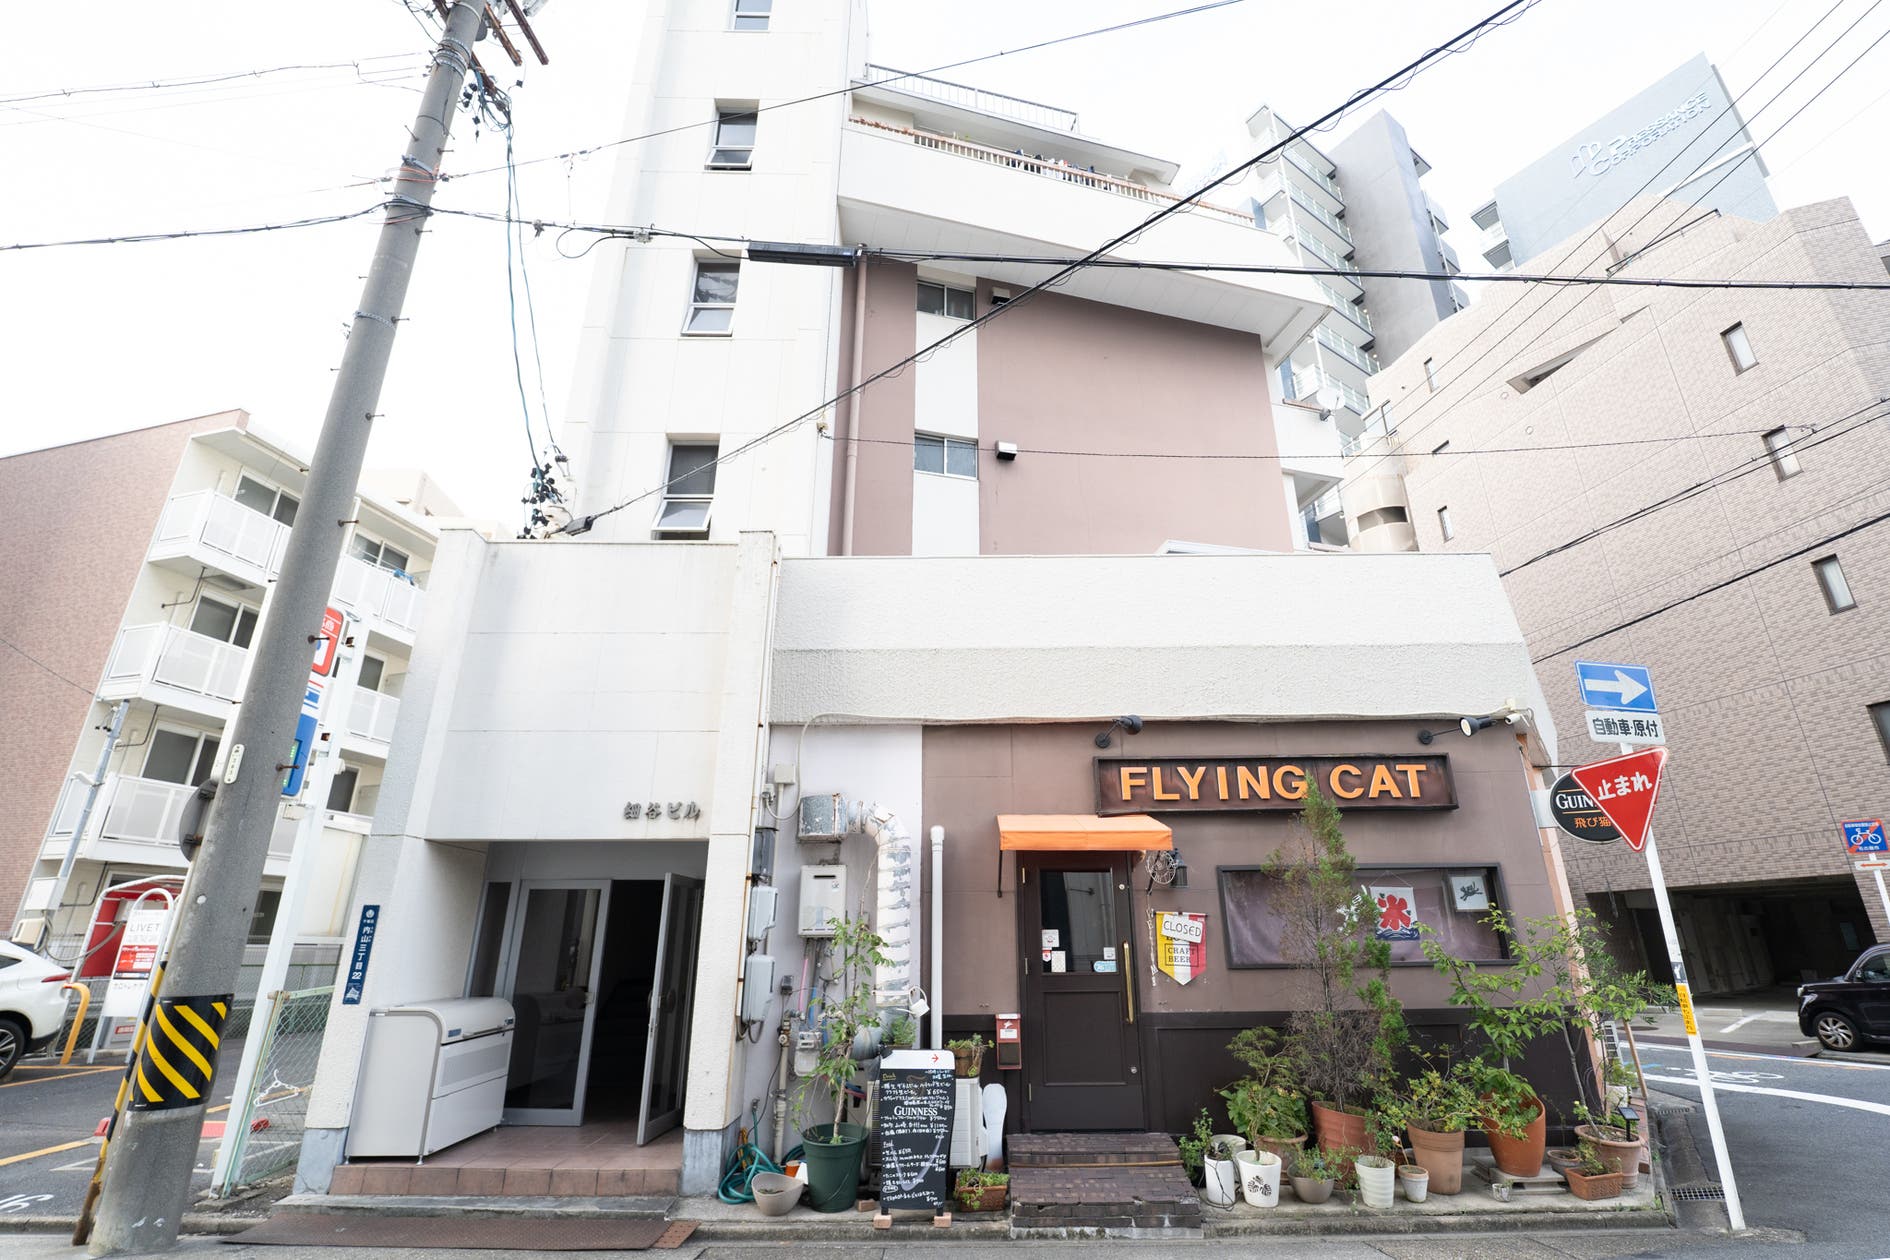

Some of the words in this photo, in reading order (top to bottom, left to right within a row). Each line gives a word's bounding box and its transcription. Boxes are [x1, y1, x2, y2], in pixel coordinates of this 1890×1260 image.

[1120, 766, 1308, 800] FLYING
[1329, 764, 1427, 798] CAT
[1597, 771, 1653, 801] 止まれ
[1555, 793, 1598, 809] GUIN
[1163, 920, 1202, 937] CLOSED
[1168, 955, 1192, 963] BEER
[894, 1105, 938, 1116] GUINNESS
